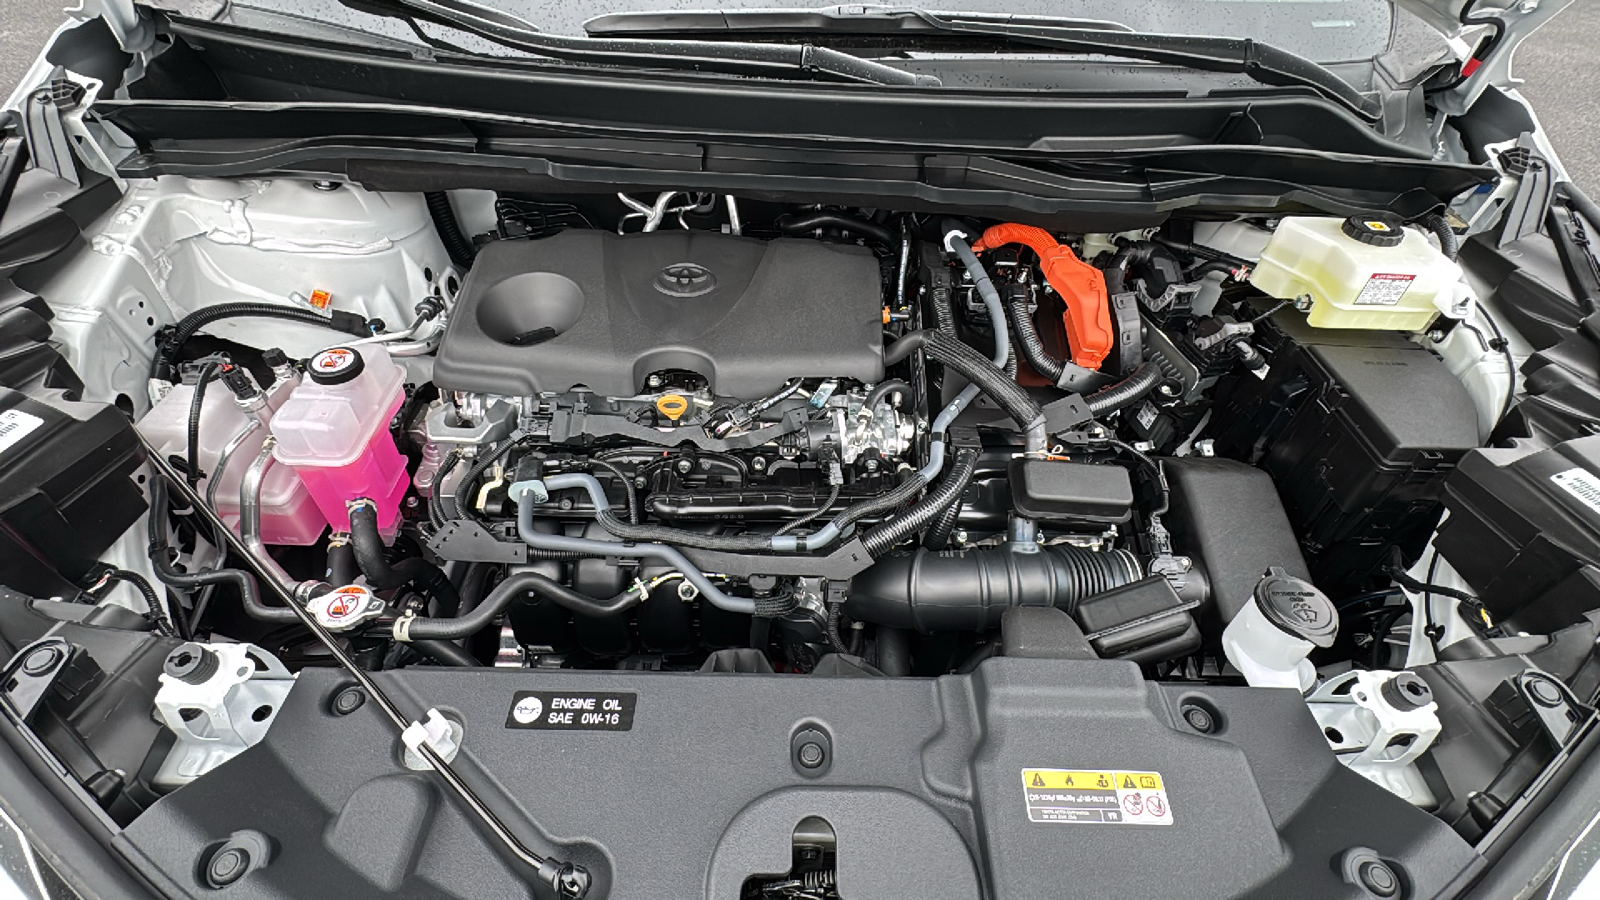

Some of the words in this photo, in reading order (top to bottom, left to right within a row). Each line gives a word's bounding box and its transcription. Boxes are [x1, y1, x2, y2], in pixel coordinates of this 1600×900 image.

[551, 697, 596, 710] ENGINE
[602, 699, 622, 711] OIL
[547, 712, 574, 724] SAE
[581, 712, 620, 725] 0W-16
